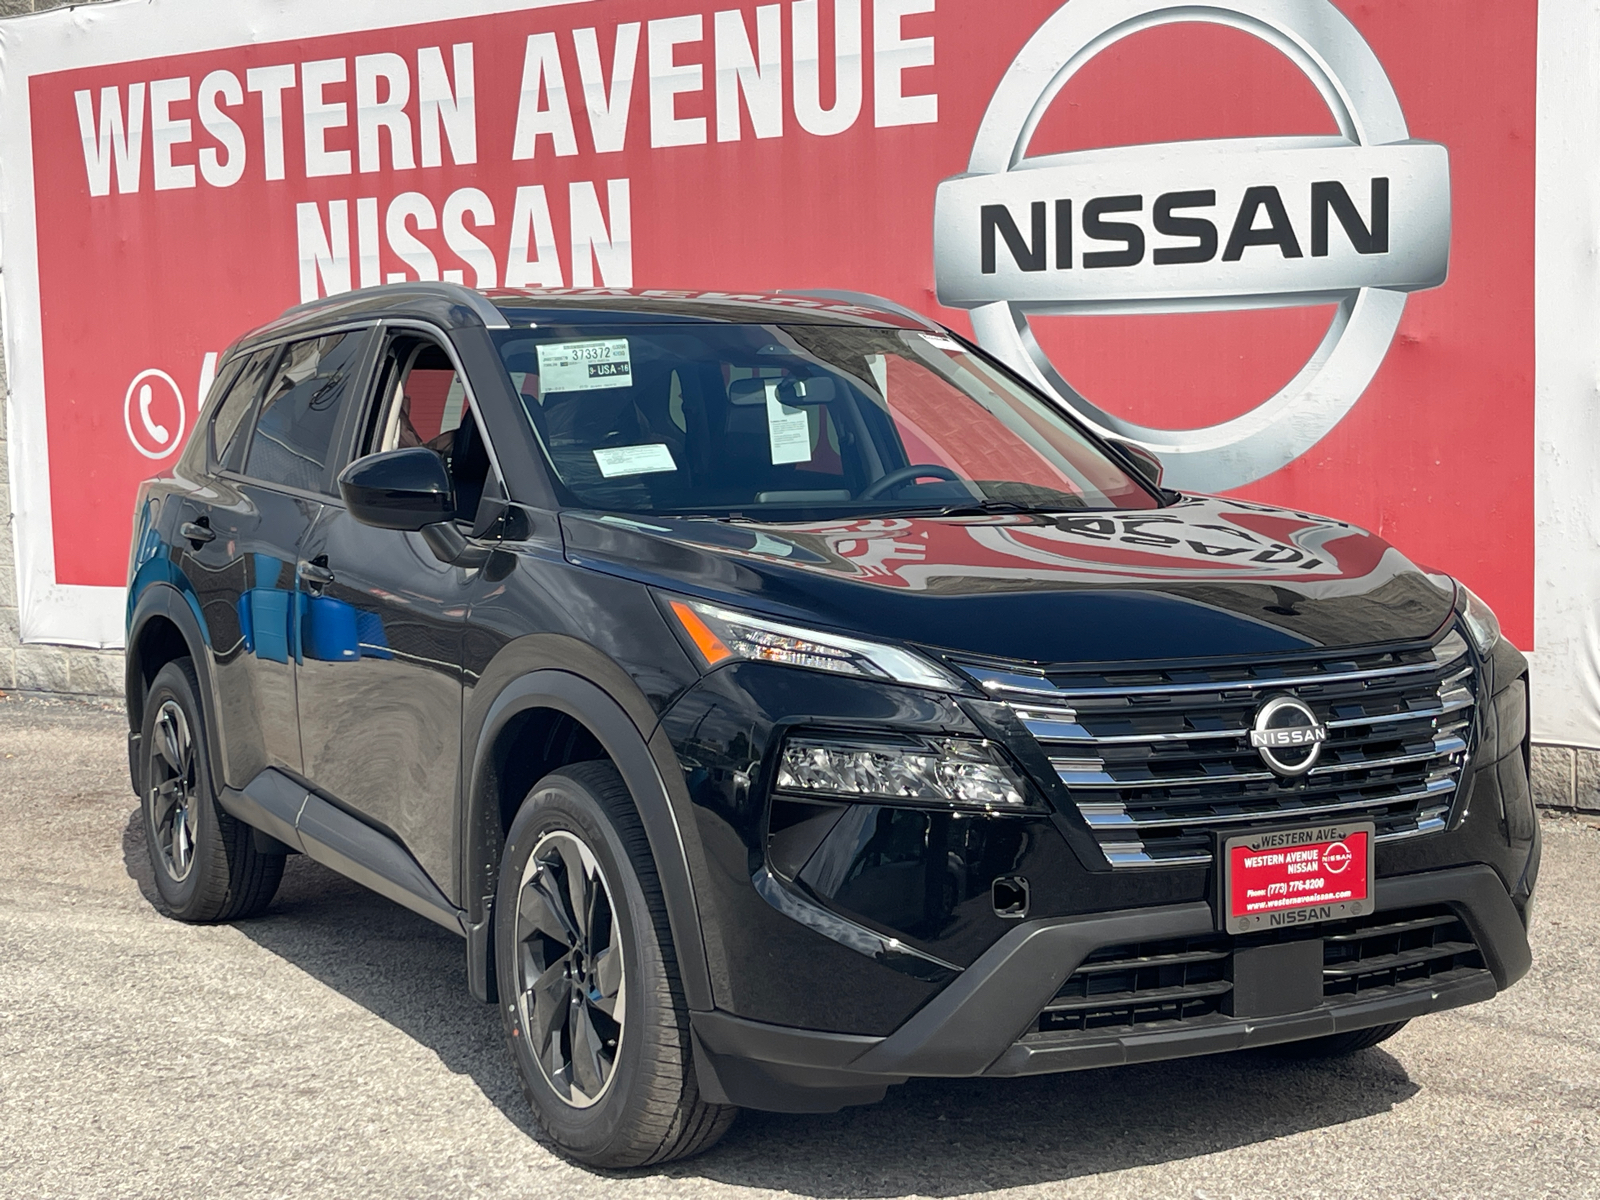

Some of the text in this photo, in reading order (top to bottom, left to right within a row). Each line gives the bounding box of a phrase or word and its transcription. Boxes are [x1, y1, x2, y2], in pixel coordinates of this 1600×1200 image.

[74, 0, 938, 197] WESTERN AVENUE
[980, 177, 1390, 275] NISSAN
[295, 178, 634, 306] NISSAN
[572, 347, 611, 361] 373372
[1253, 727, 1325, 745] NISSAN
[1261, 831, 1313, 847] WESTERN
[1244, 849, 1319, 869] WESTERN AVENUE
[1322, 853, 1352, 863] NISSAN
[1287, 861, 1319, 875] NISSAN
[1267, 883, 1287, 897] (773)
[1289, 878, 1325, 892] 776-8200
[1270, 906, 1331, 926] NISSAN
